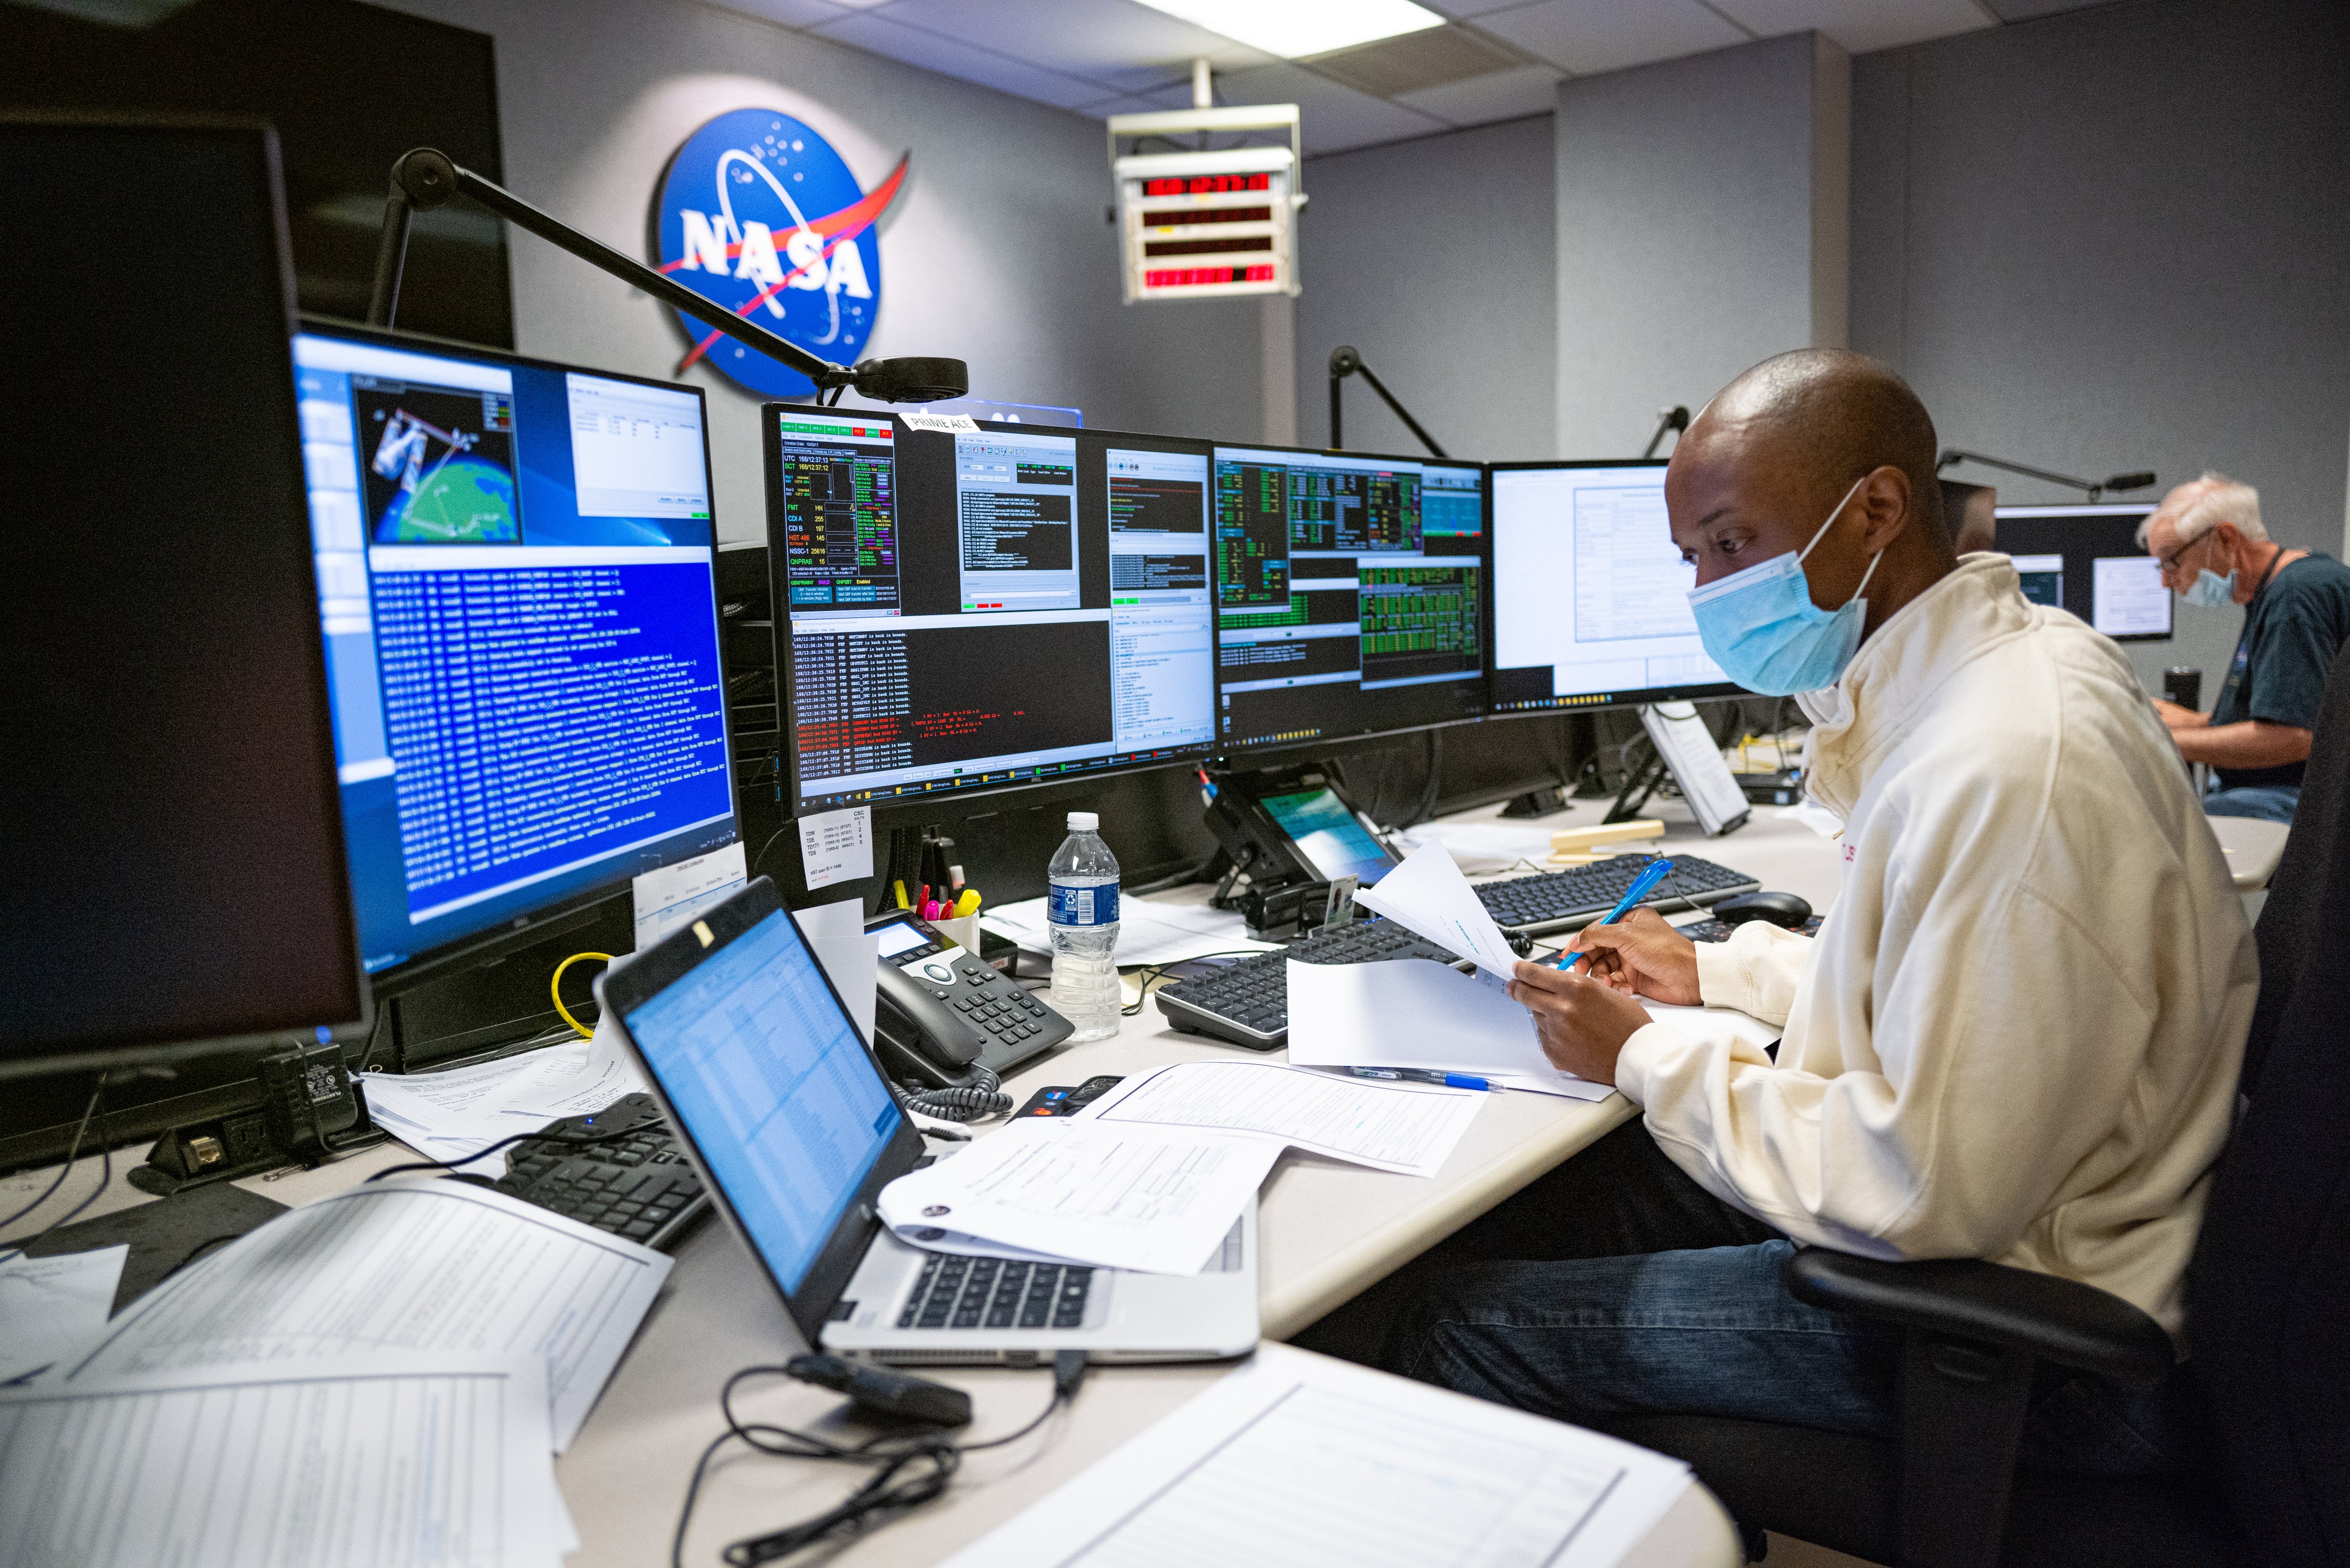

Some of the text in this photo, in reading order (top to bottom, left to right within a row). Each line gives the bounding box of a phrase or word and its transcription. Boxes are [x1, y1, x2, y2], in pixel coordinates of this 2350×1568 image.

[679, 208, 873, 299] NASA
[911, 418, 972, 428] PRIME ACE
[313, 1091, 341, 1103] PLANTRONIC
